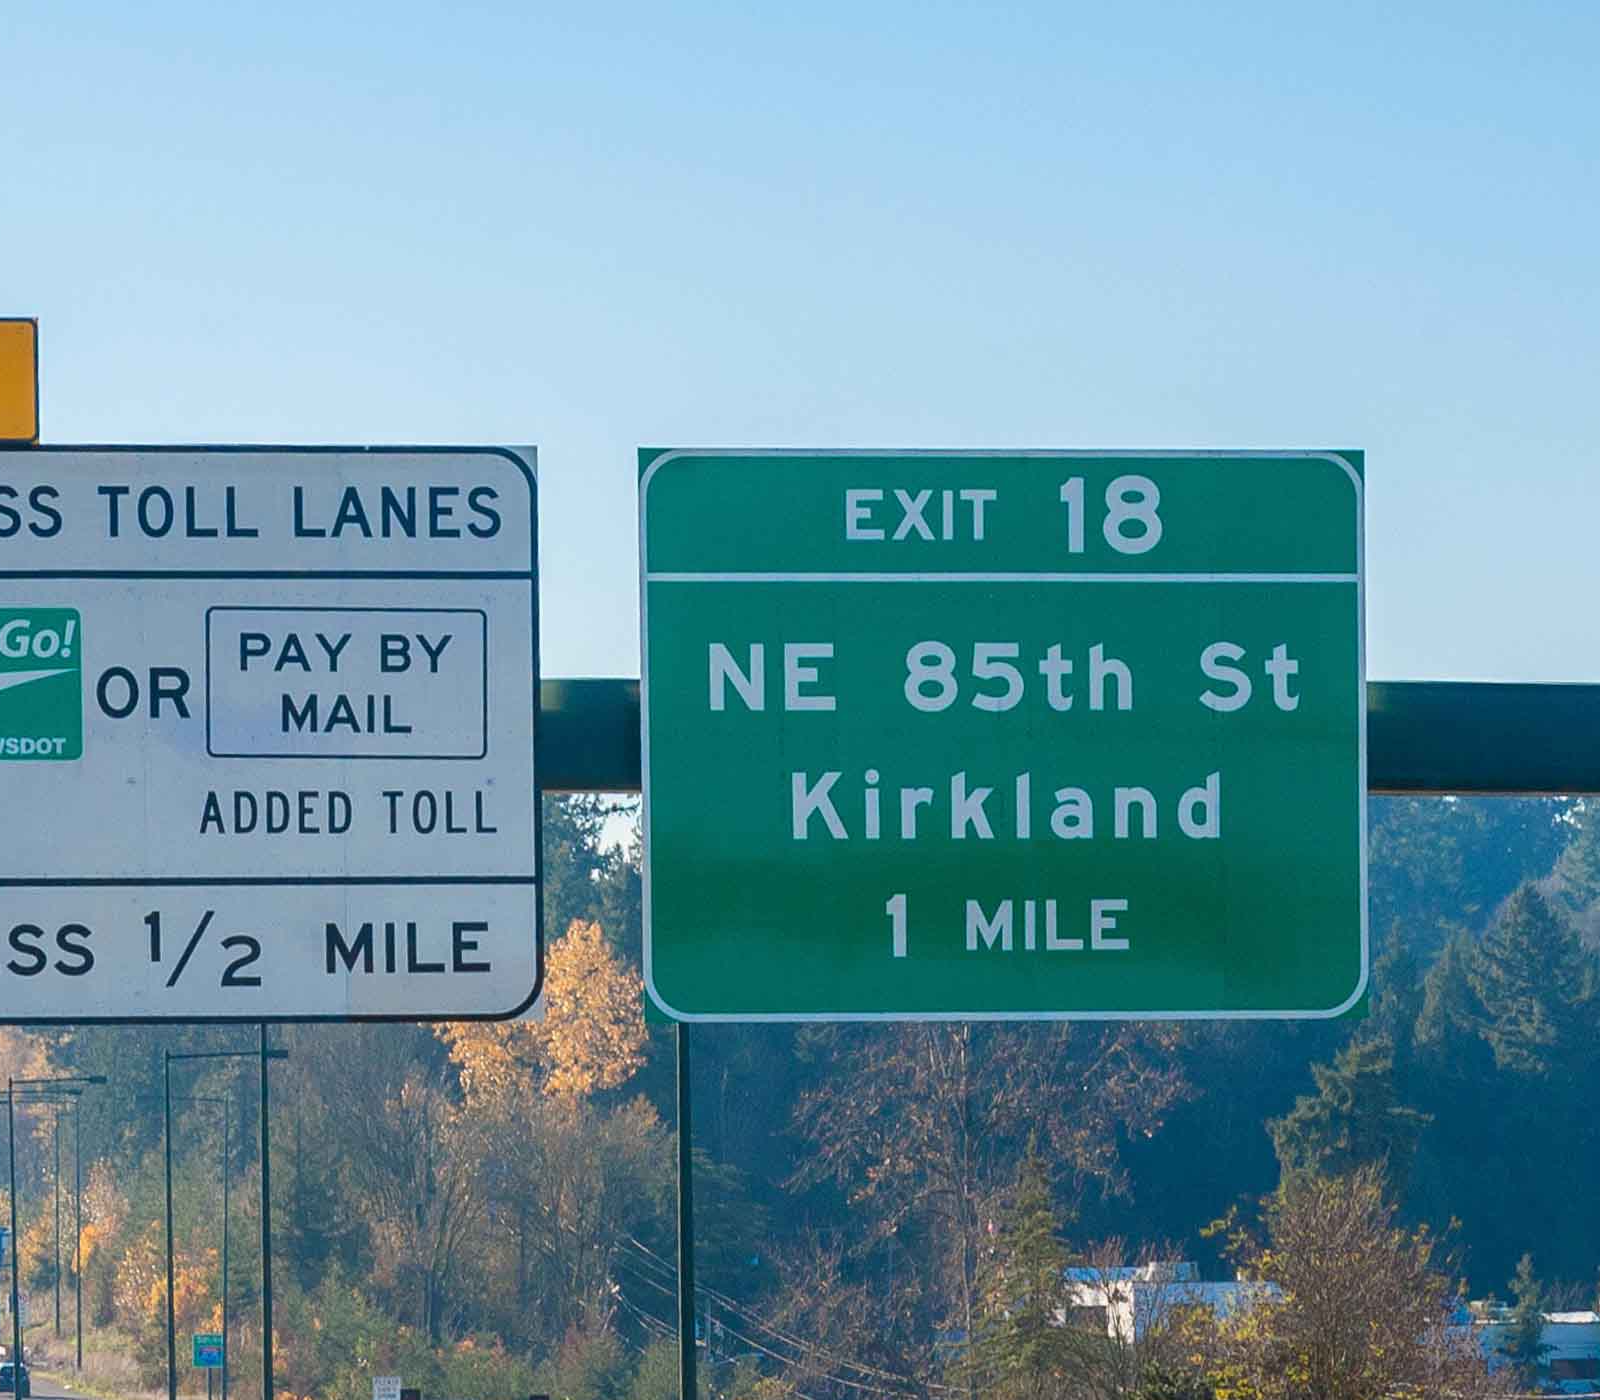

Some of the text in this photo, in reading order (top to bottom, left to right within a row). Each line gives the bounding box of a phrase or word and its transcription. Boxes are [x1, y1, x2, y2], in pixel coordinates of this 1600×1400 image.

[98, 485, 258, 539] TOLL
[293, 485, 502, 540] LANES
[845, 474, 1164, 556] EXIT 18
[238, 632, 454, 674] PAY BY
[708, 640, 1301, 713] NE 85th St
[96, 665, 192, 720] OR
[280, 693, 412, 735] MAIL
[199, 790, 498, 835] ADDED TOLL
[790, 768, 1221, 841] Kirkland
[142, 910, 263, 988] 1/2
[324, 920, 491, 976] MILE
[885, 893, 1130, 958] 1 MILE
